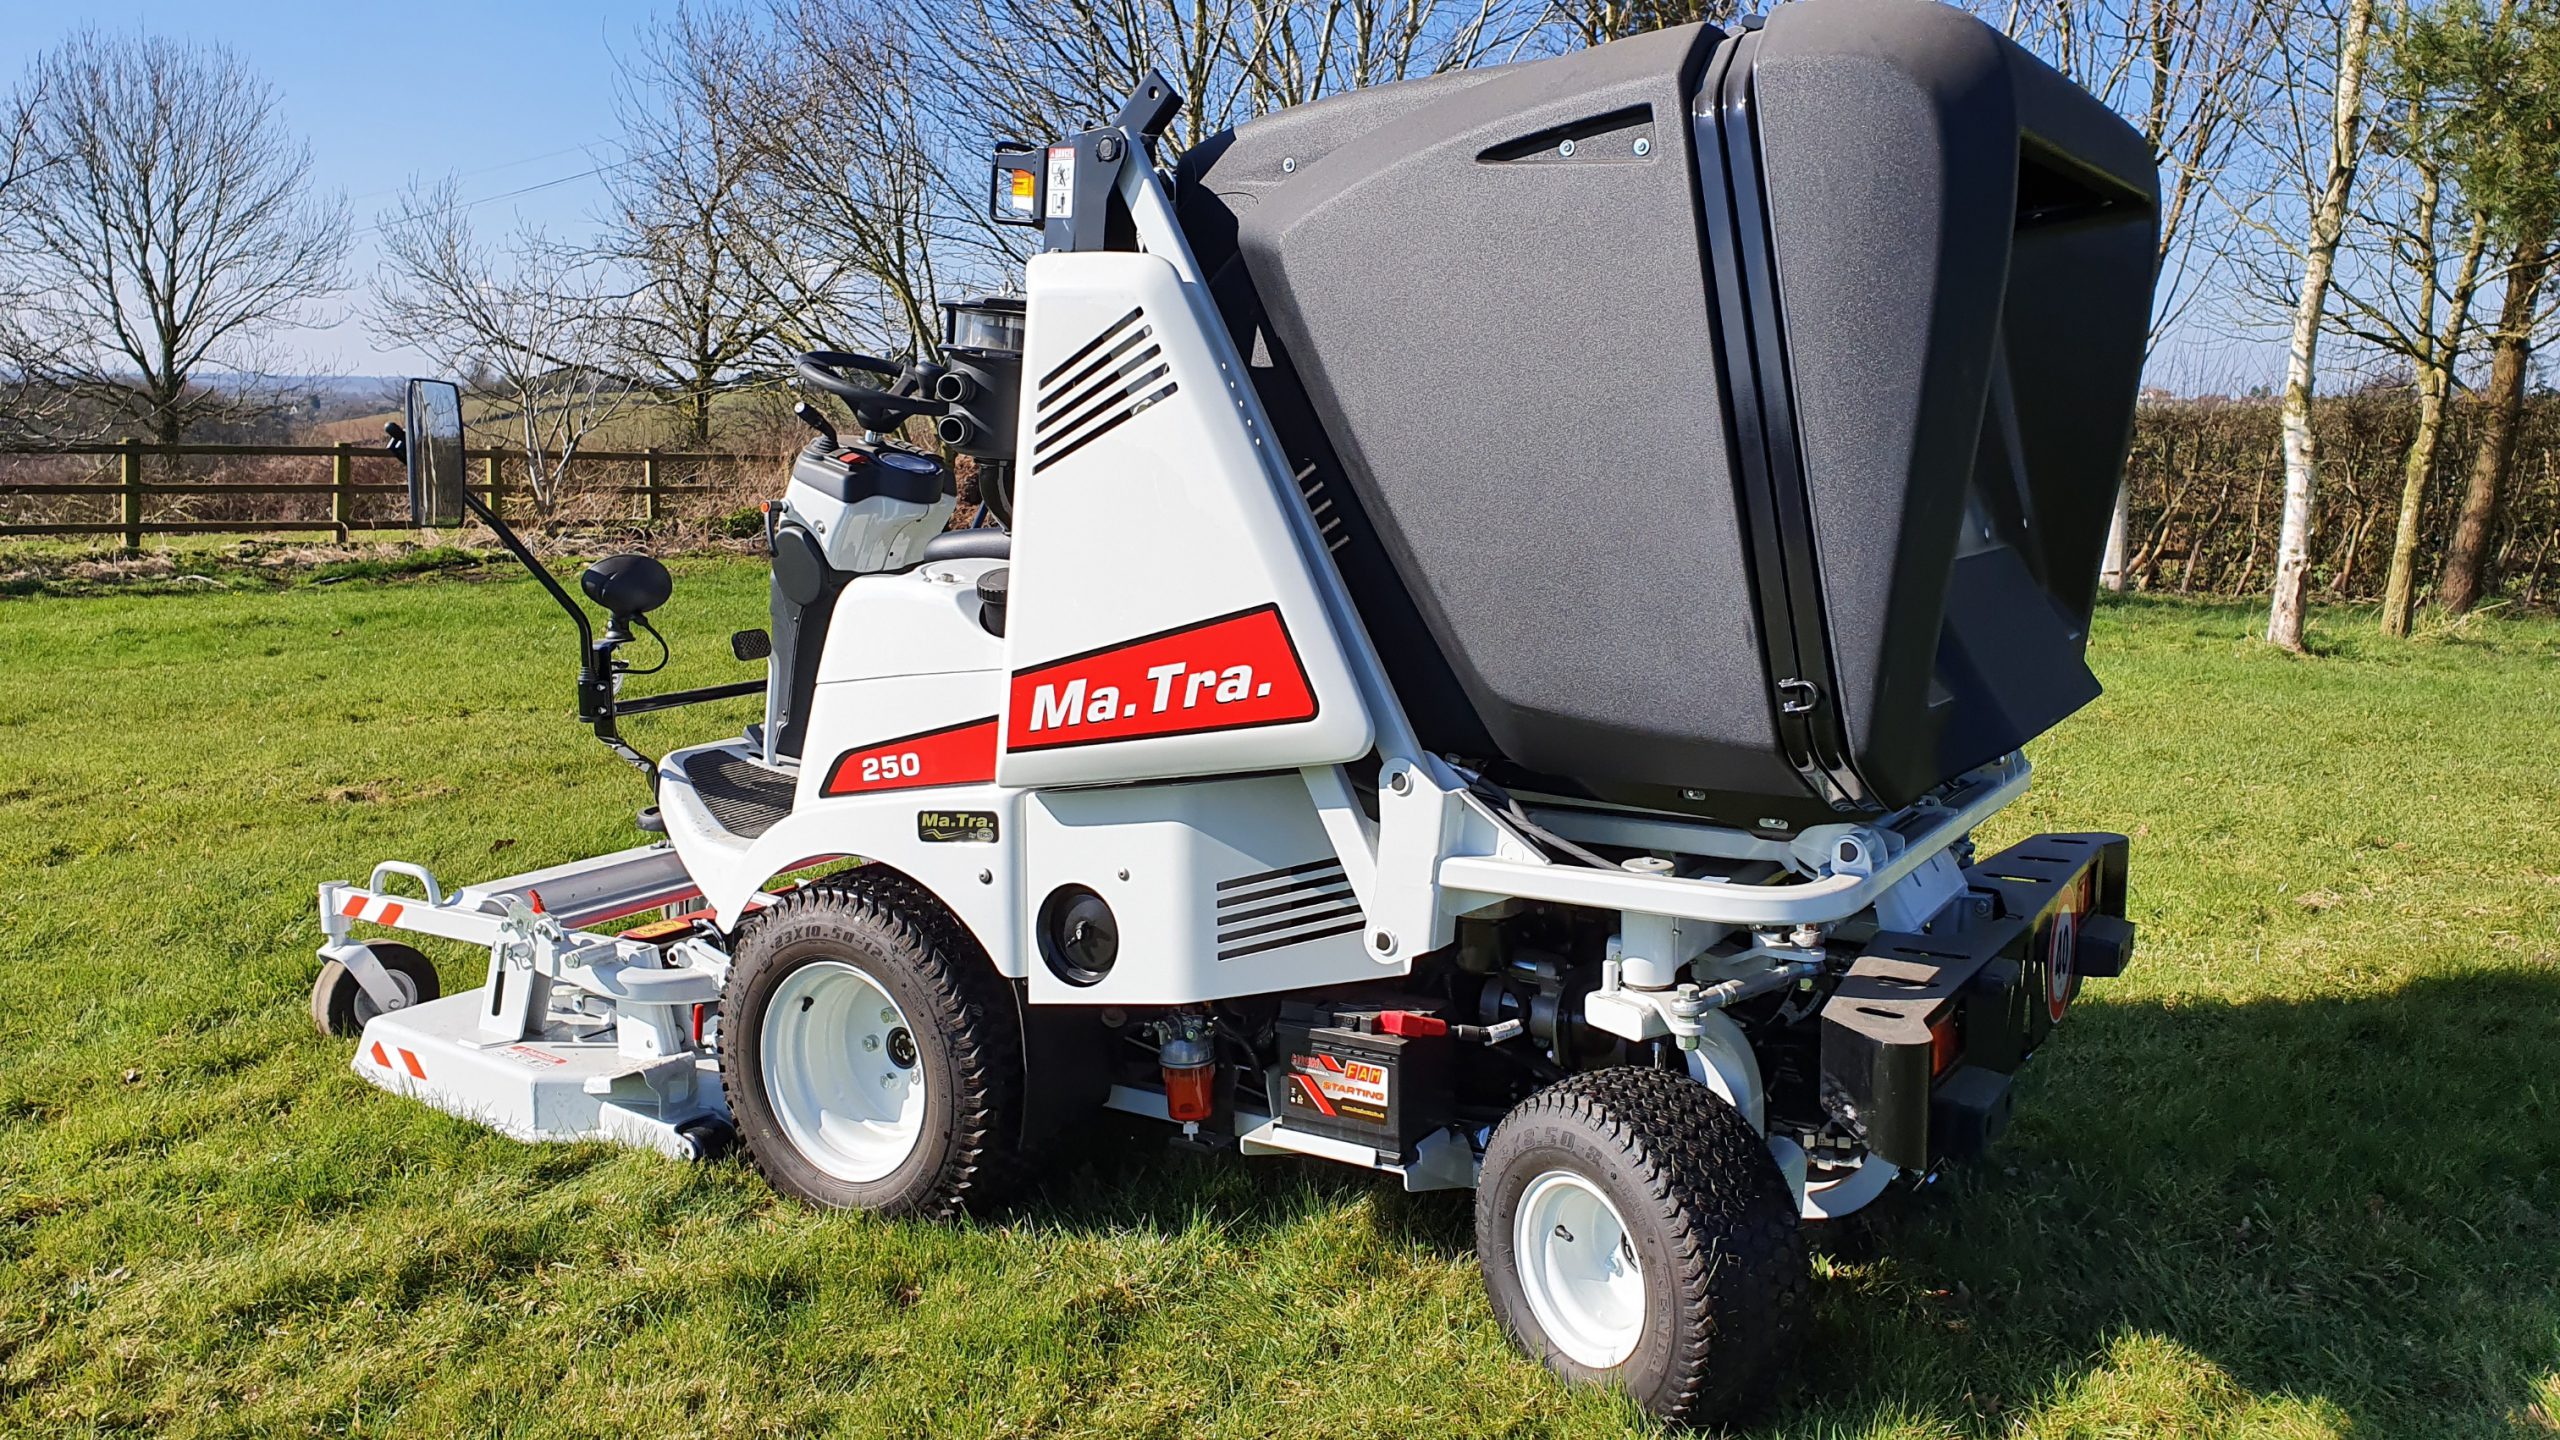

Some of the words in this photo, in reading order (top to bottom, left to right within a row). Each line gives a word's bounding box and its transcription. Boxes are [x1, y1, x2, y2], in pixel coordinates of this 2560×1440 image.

[1029, 660, 1273, 733] Ma.Tra.
[861, 751, 921, 782] 250
[921, 812, 994, 828] Ma.Tra.
[773, 924, 884, 961] 23X10.50-12
[2054, 924, 2070, 981] 40
[1346, 1063, 1383, 1085] FAM
[1322, 1079, 1385, 1101] STARTING
